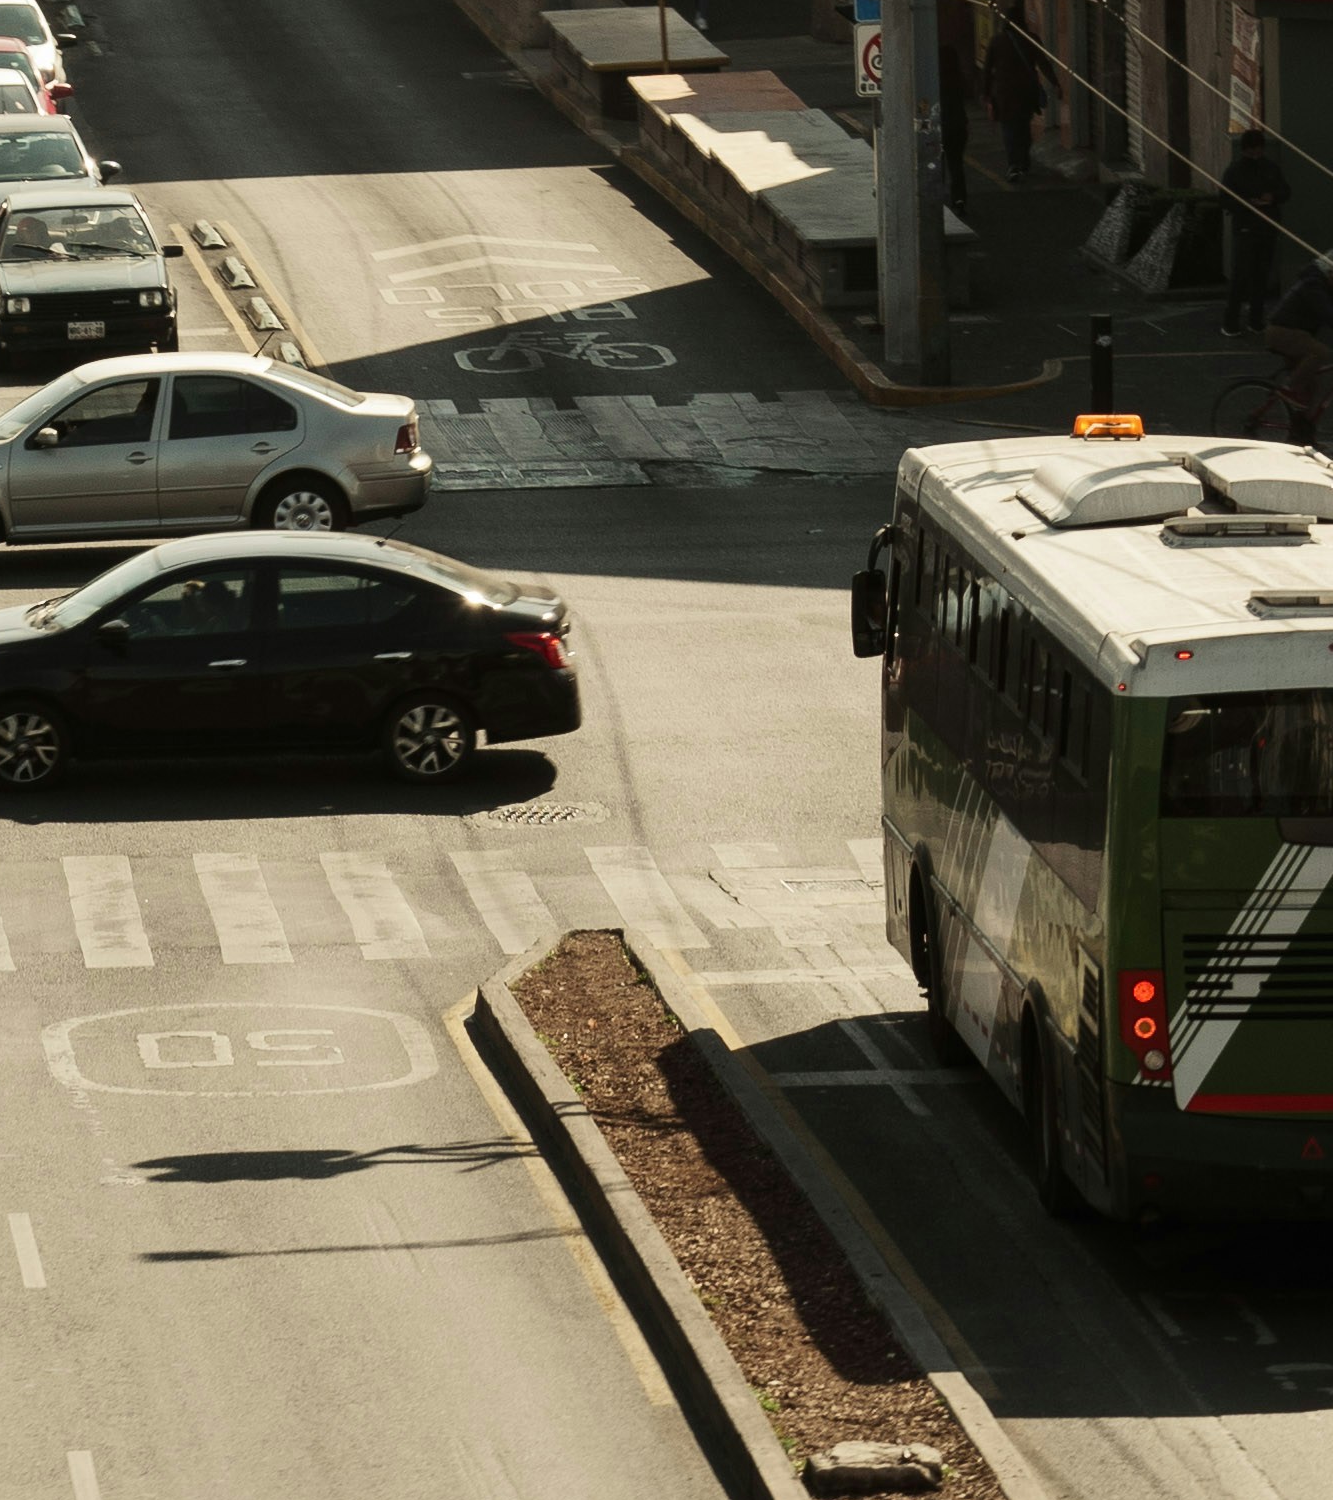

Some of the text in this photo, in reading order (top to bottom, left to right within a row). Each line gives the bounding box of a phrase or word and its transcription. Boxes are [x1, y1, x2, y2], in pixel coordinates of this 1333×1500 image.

[379, 276, 651, 305] SOLO
[424, 300, 638, 327] BUS
[135, 1029, 344, 1068] 50
